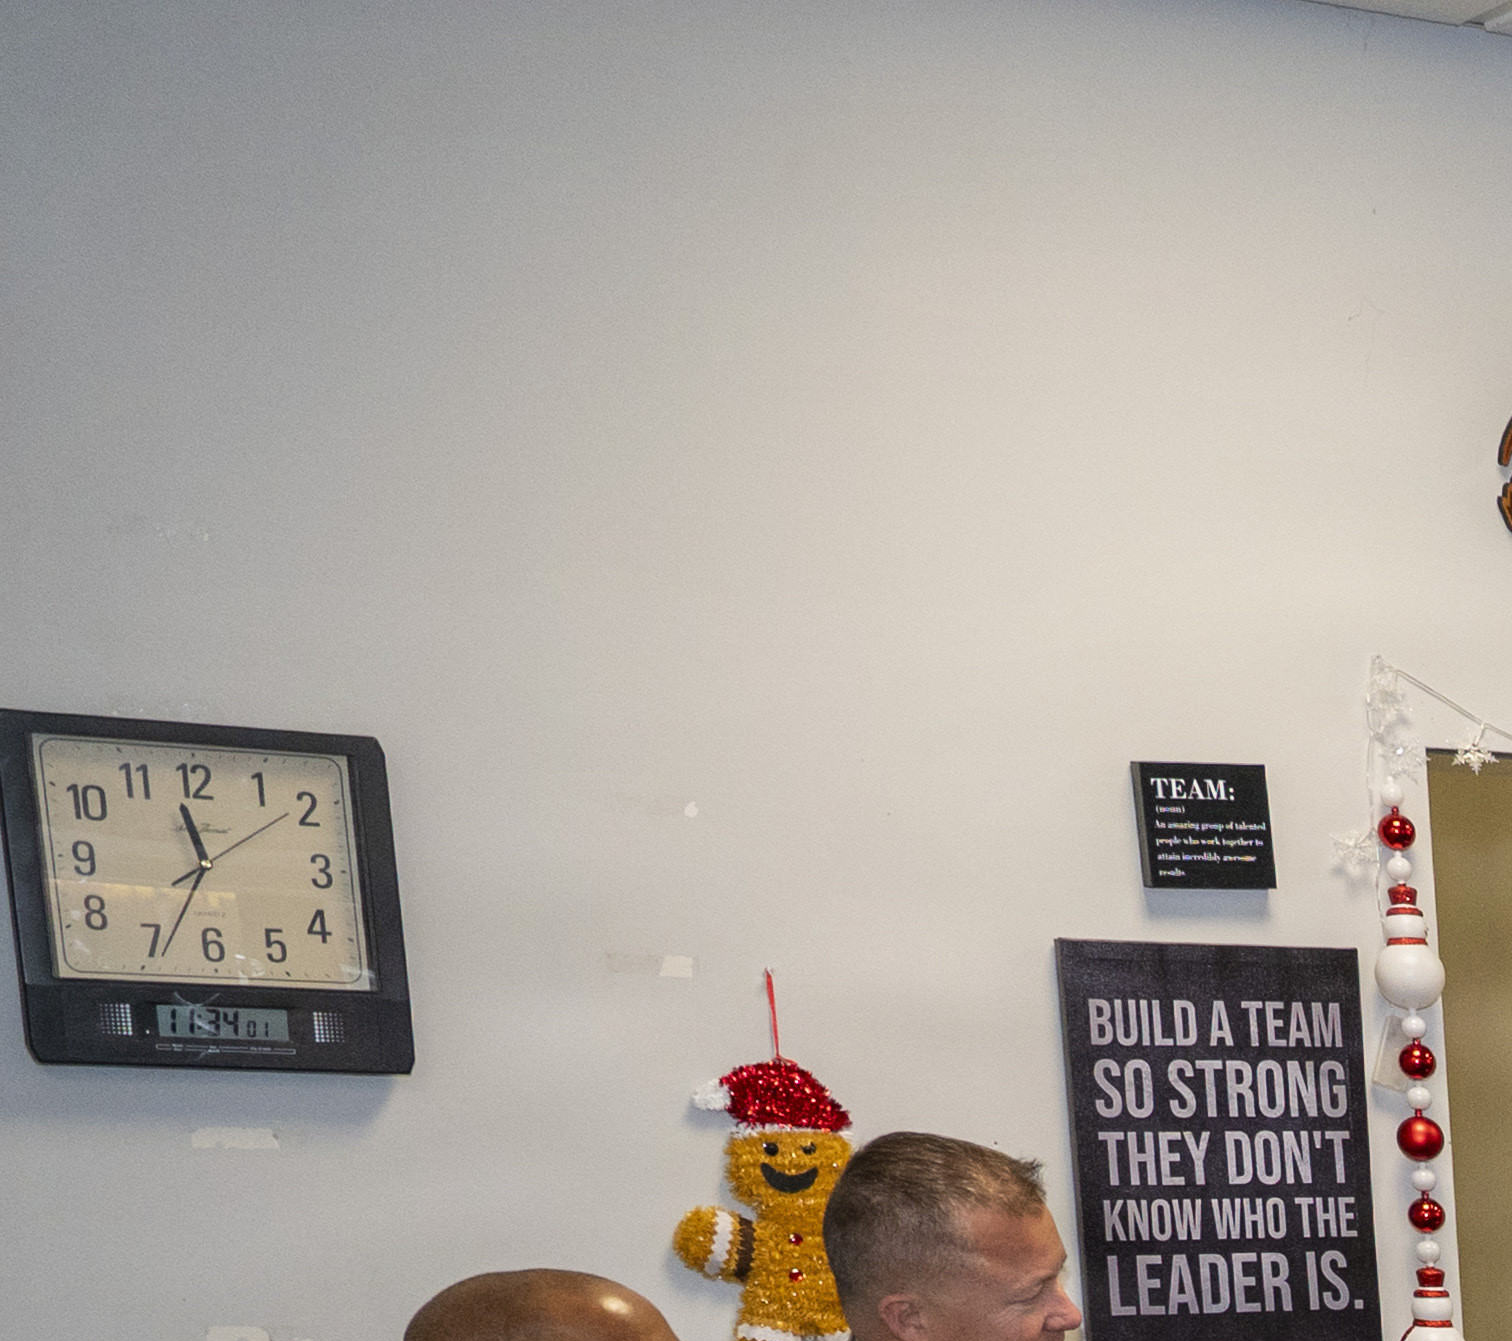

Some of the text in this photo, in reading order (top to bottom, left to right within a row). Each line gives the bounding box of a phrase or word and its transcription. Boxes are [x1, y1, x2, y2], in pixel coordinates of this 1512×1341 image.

[119, 763, 153, 800] 11
[175, 763, 214, 801] 12
[251, 772, 268, 806] 1
[1150, 777, 1235, 801] TEAM:
[66, 783, 108, 822] 10
[295, 792, 322, 828] 2
[1201, 822, 1224, 832] group
[72, 840, 97, 876] 9
[310, 853, 334, 889] 3
[83, 895, 109, 931] 8
[306, 909, 332, 944] 4
[140, 924, 163, 959] 7
[201, 927, 226, 962] 6
[264, 927, 288, 962] 5
[170, 1008, 239, 1037] 11:34
[1087, 998, 1344, 1048] BUILD A TEAM
[1092, 1060, 1348, 1118] SO STRONG
[1097, 1130, 1350, 1187] THEY DON'T
[1102, 1196, 1358, 1242] KNOW WHO THE
[1106, 1250, 1364, 1316] LEADER IS.
